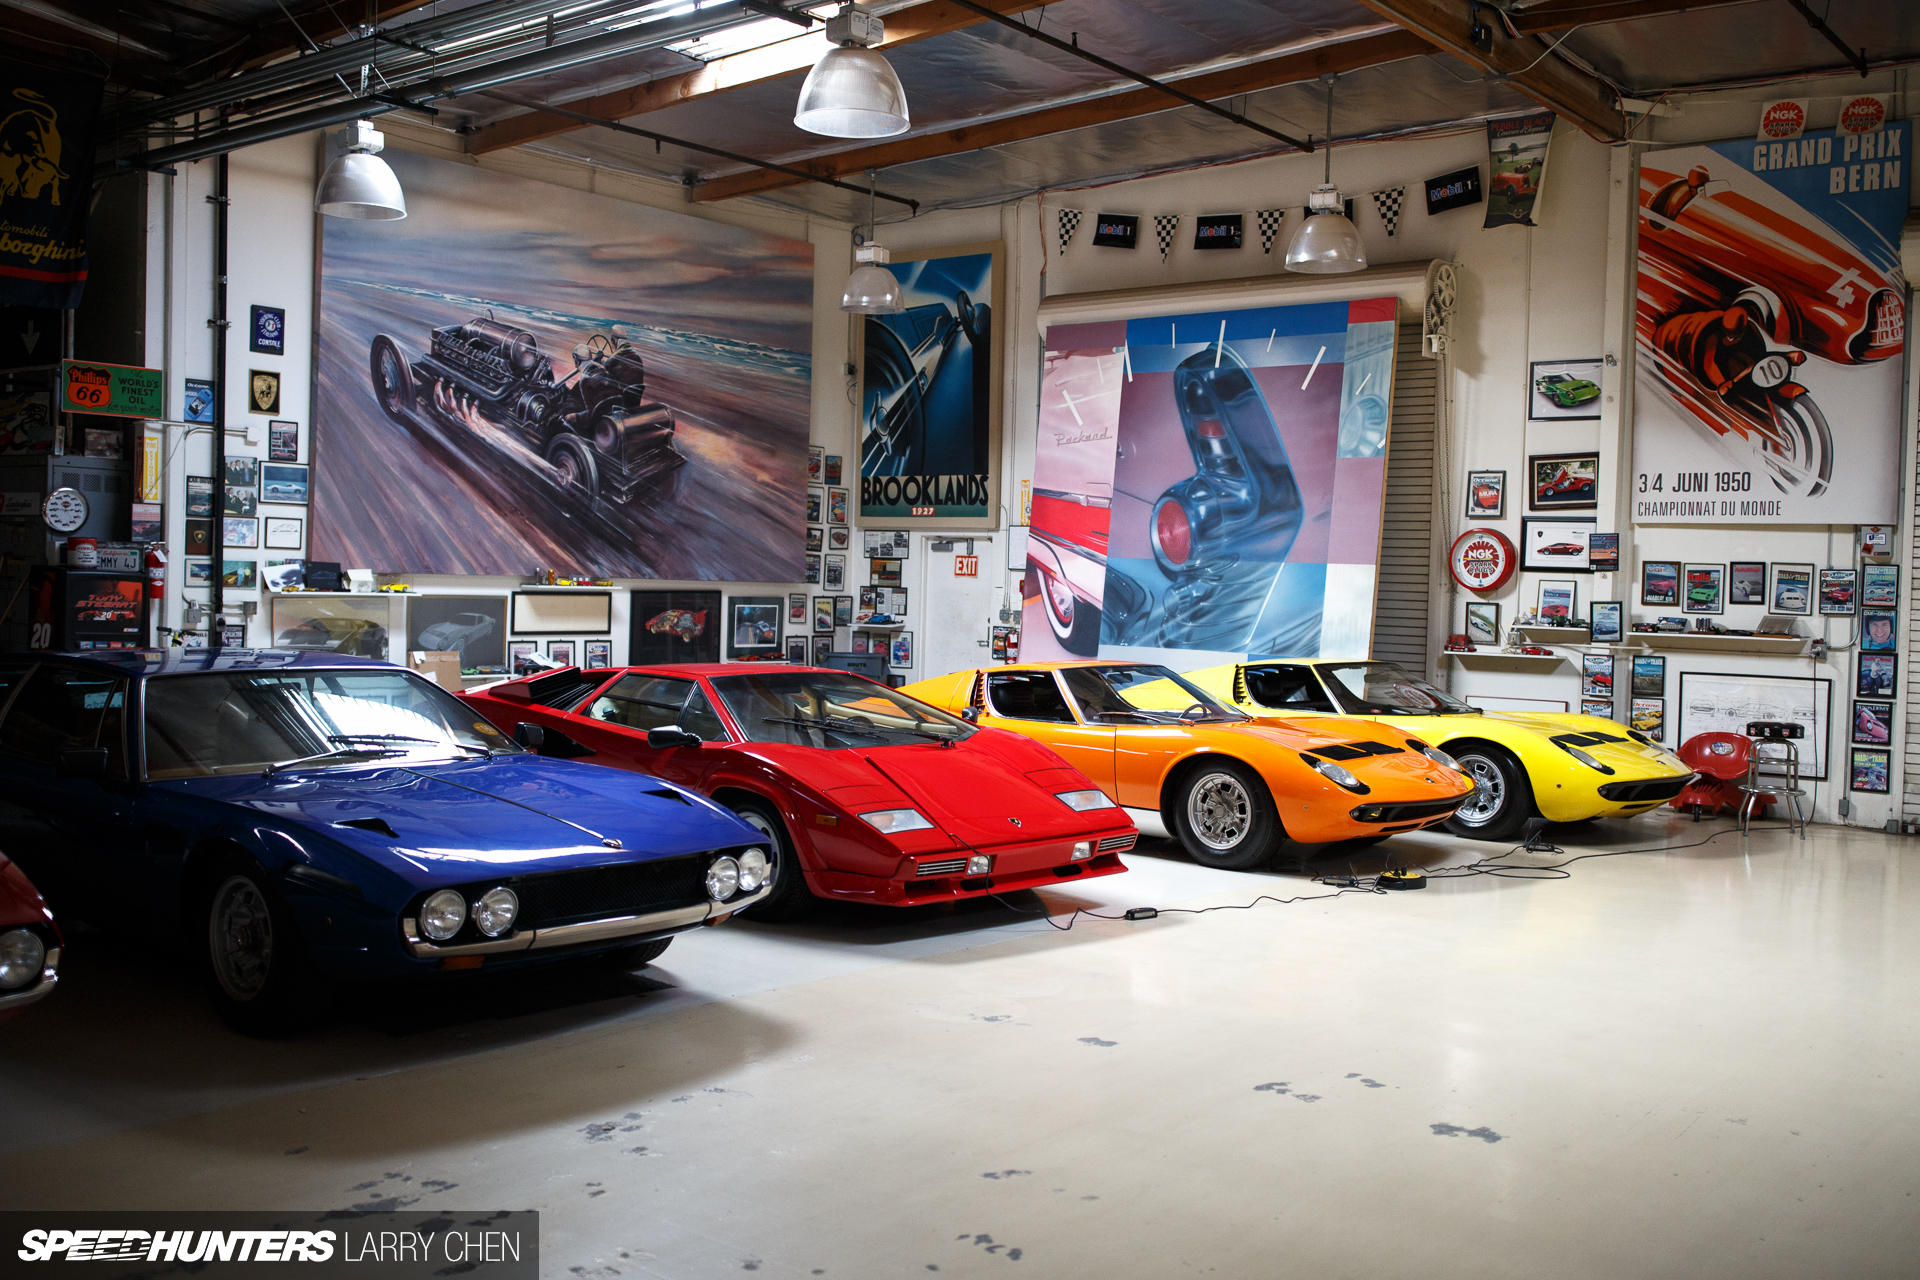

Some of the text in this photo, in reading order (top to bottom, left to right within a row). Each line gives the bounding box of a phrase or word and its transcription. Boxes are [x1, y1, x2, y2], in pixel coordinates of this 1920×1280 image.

[1770, 110, 1799, 120] NGK
[1849, 105, 1879, 115] NGK
[1491, 116, 1552, 132] PEBBLE BEACH
[1753, 129, 1902, 172] GRAND PRIX
[1829, 160, 1901, 195] BERN
[1429, 181, 1463, 202] Mobil
[1099, 223, 1125, 236] Mobil
[1200, 226, 1226, 238] Mobil
[1826, 267, 1862, 310] 4
[258, 338, 280, 348] CONSOLE
[69, 368, 107, 386] Phillips
[1759, 359, 1784, 385] 10
[118, 377, 159, 389] WORLD'S
[76, 386, 102, 403] 66
[121, 386, 155, 397] FINEST
[128, 396, 146, 405] OIL
[1053, 426, 1113, 447] Packard
[146, 441, 157, 449] FIRE
[1672, 472, 1709, 493] JUNI
[1714, 471, 1751, 493] 1950
[860, 475, 989, 506] BROOKLANDS
[1478, 489, 1498, 498] MIURA
[912, 506, 935, 517] 1927
[1637, 501, 1782, 517] CHAMPIONNAT DU MONDE
[103, 550, 130, 558] California
[1467, 549, 1494, 559] NGK
[124, 557, 137, 568] 4J
[956, 557, 977, 575] EXIT
[1688, 572, 1711, 581] Italia
[75, 600, 138, 608] STEWART
[88, 594, 124, 602] TONY
[30, 622, 52, 649] 20
